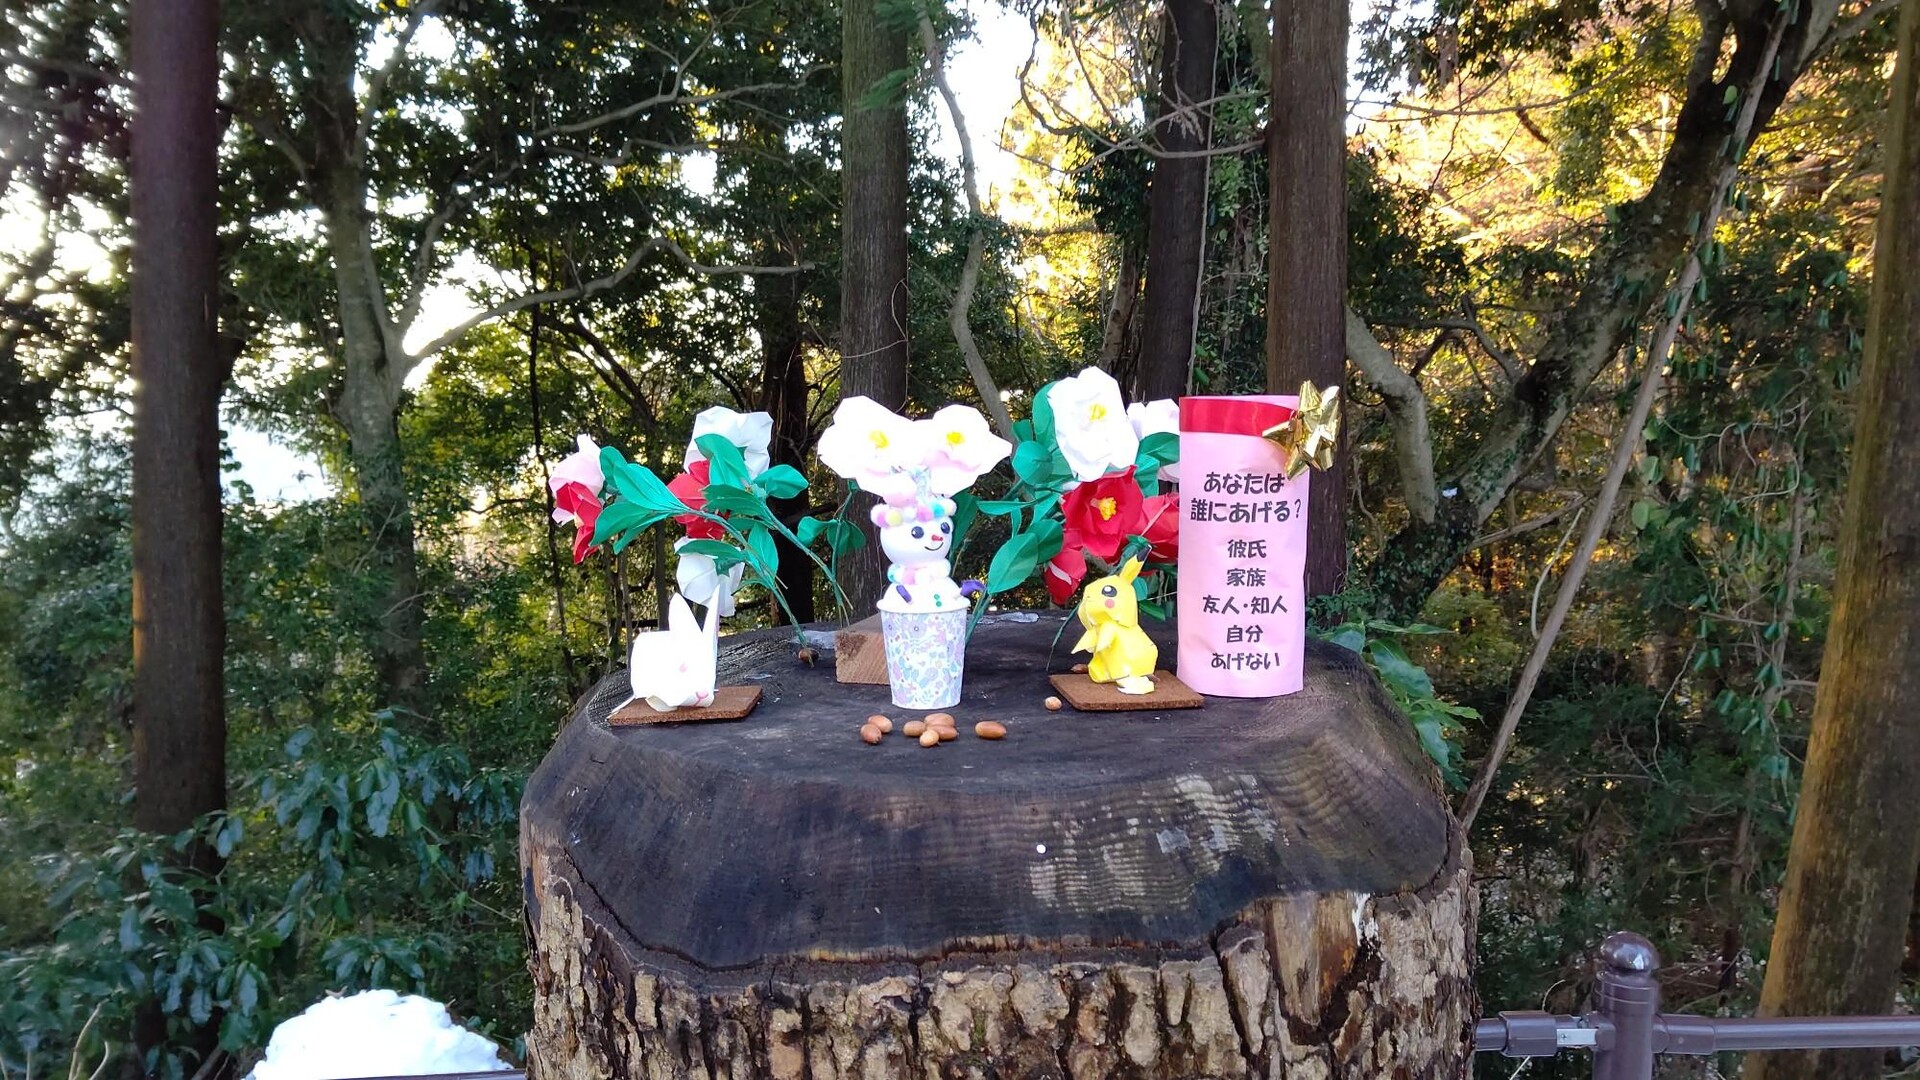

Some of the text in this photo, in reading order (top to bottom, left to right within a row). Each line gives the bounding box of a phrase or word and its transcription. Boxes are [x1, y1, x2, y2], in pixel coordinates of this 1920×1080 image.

[1203, 471, 1285, 495] あなたは
[1190, 497, 1302, 523] 誰にあげる？
[1227, 539, 1267, 559] 彼氏
[1226, 567, 1266, 587] 家族
[1203, 594, 1288, 615] 友人・知人
[1226, 624, 1263, 643] 自分
[1211, 652, 1280, 671] あげない
